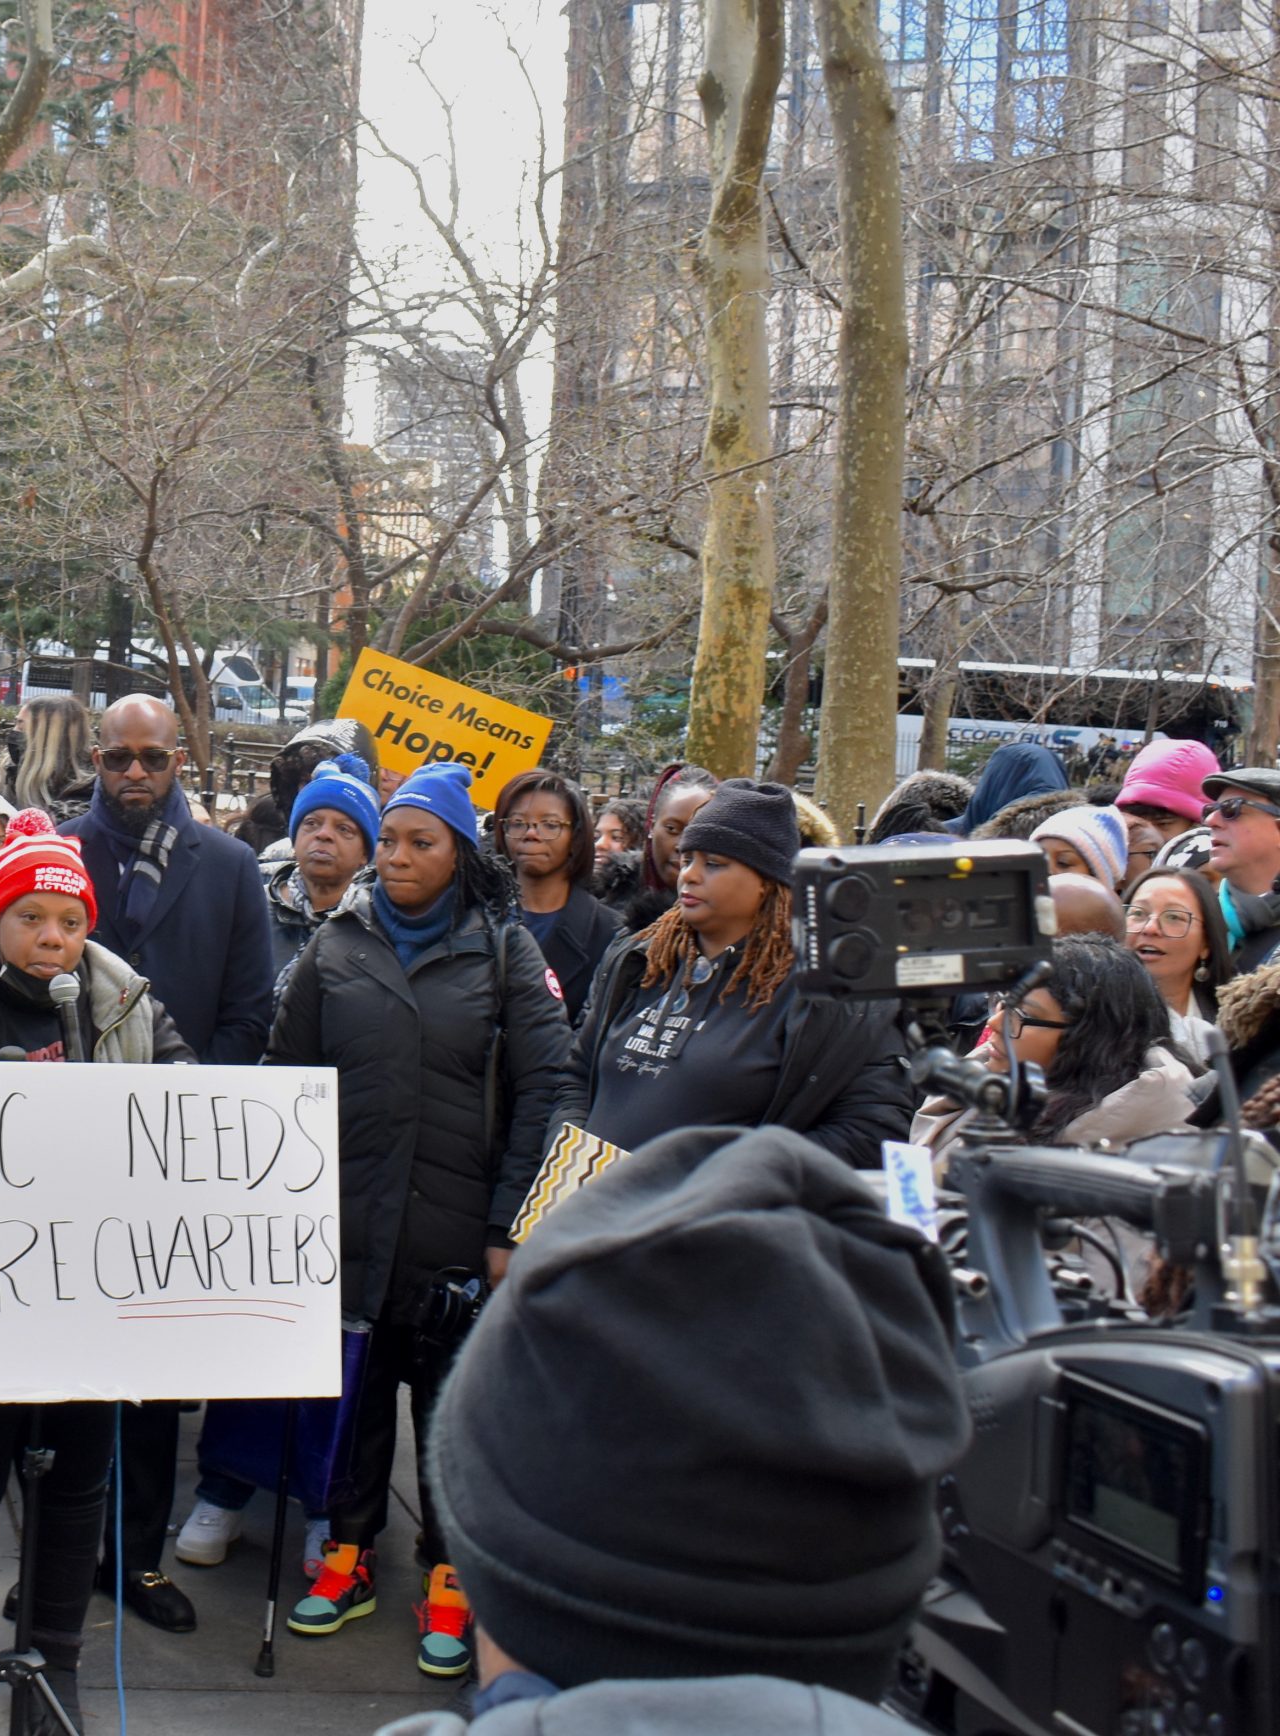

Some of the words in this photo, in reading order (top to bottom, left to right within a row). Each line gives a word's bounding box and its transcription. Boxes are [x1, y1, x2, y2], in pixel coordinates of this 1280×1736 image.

[362, 667, 445, 714] Choice
[447, 701, 535, 750] Means
[948, 727, 1017, 742] CCORD
[374, 710, 497, 779] Hope!
[33, 881, 81, 896] ACTION
[36, 874, 87, 890] DEMAND
[128, 1090, 325, 1193] NEEDS
[94, 1212, 338, 1301] CHARTERS
